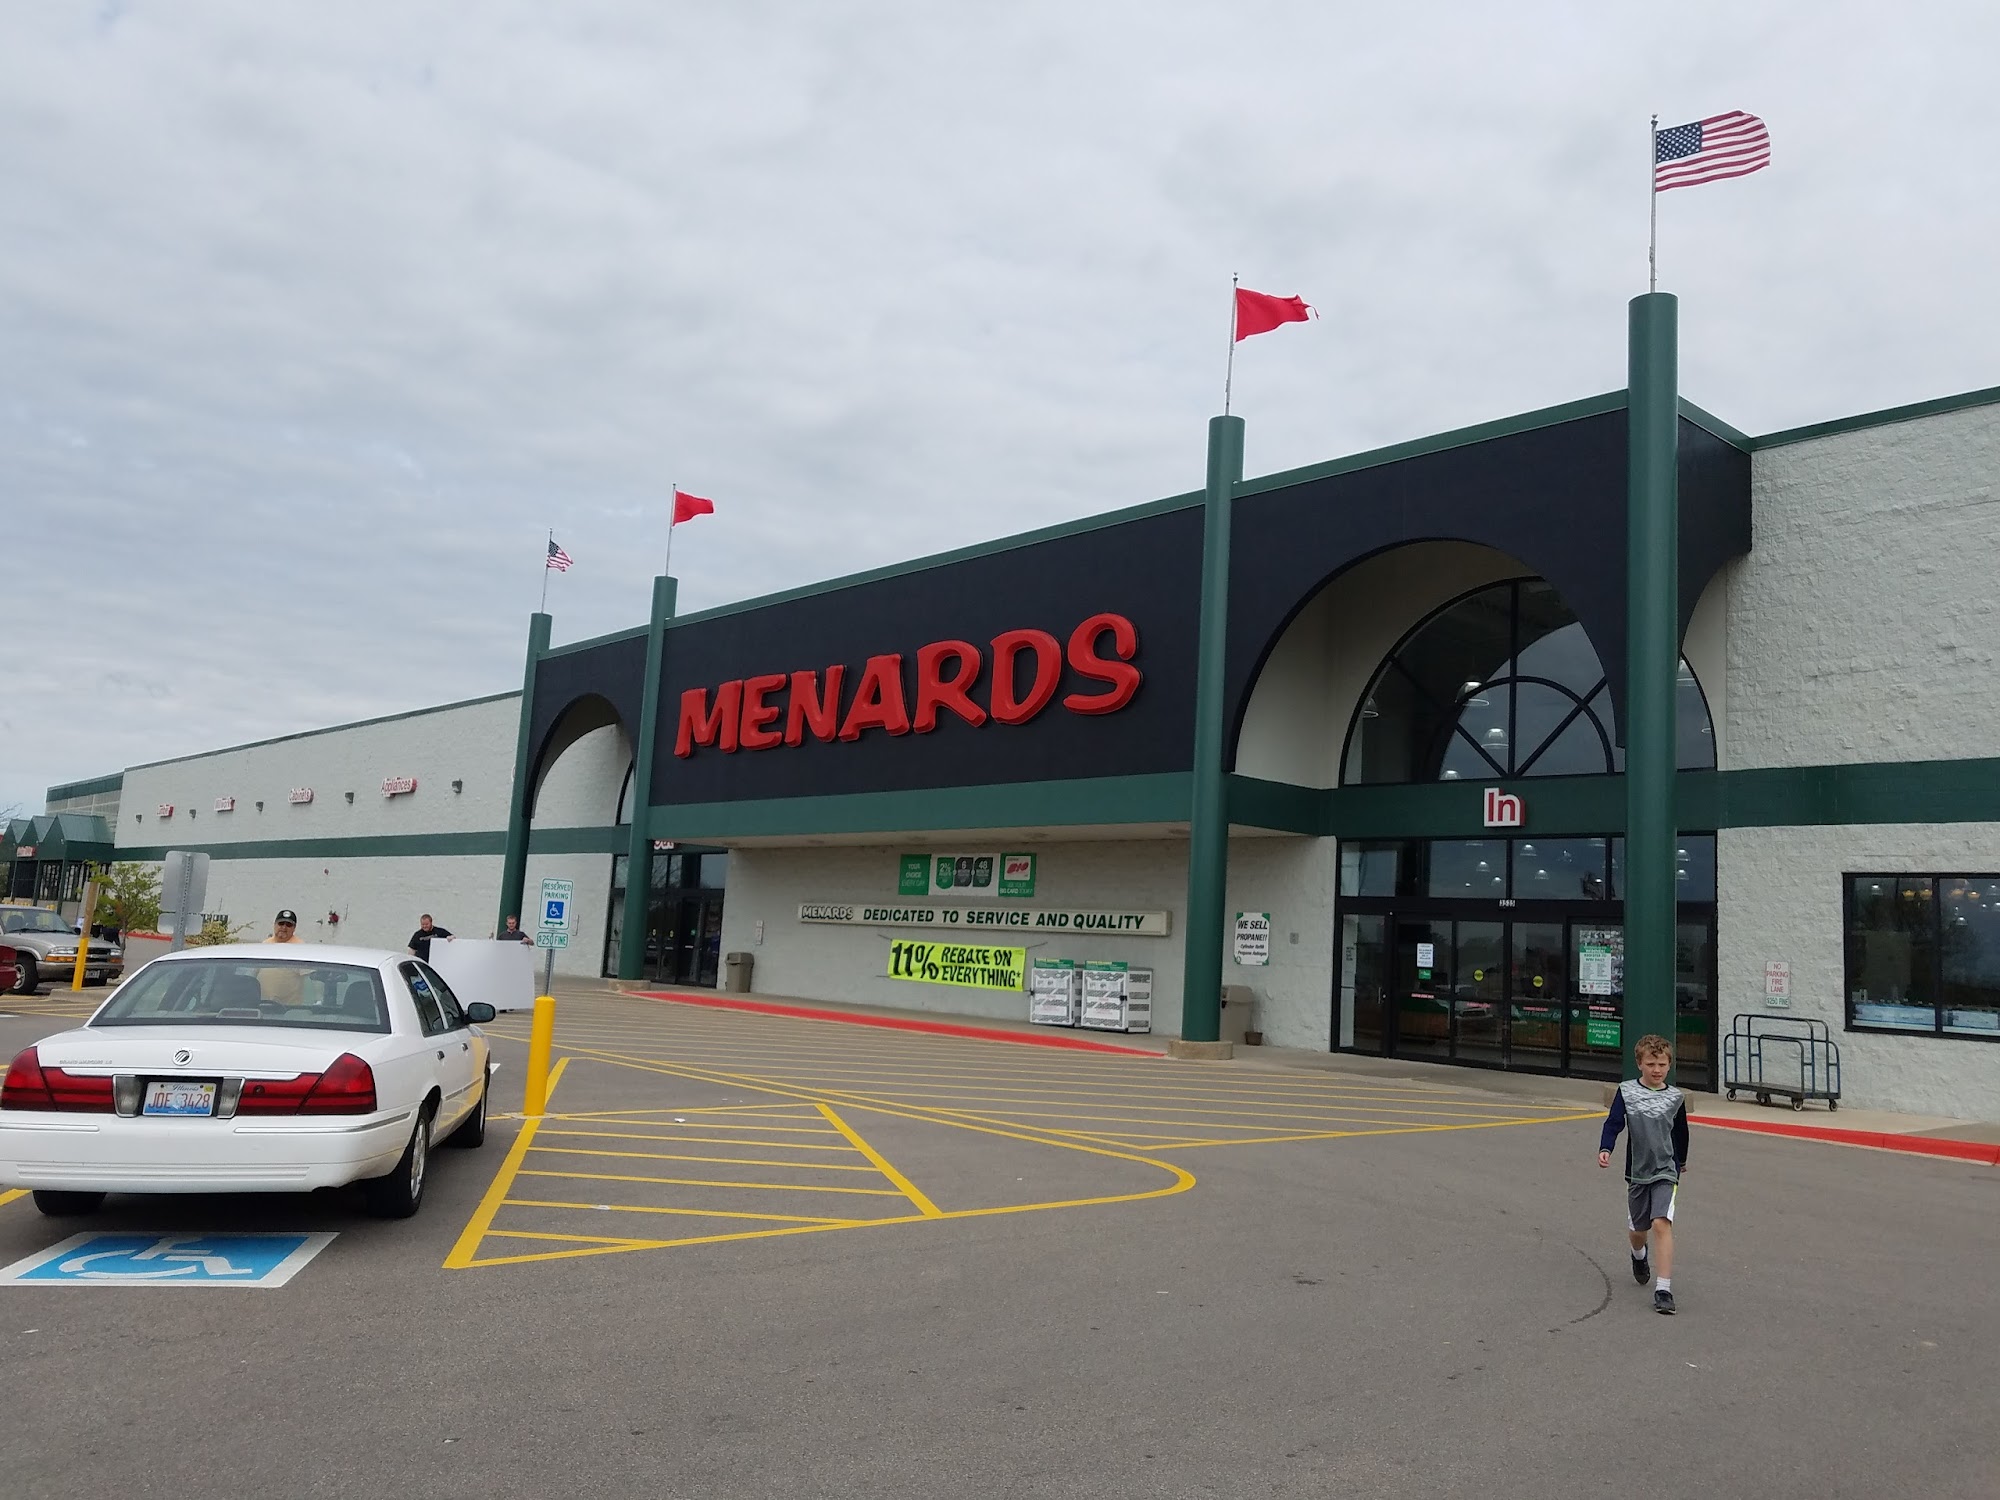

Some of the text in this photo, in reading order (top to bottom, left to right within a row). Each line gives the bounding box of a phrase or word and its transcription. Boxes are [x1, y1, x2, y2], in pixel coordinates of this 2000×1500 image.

[674, 612, 1142, 759] MENARDS
[381, 777, 413, 796] Appliances
[1486, 790, 1518, 825] In
[940, 862, 952, 872] 2%
[961, 860, 967, 869] 6
[978, 860, 988, 869] 48
[544, 883, 571, 891] RESERVED
[544, 891, 569, 900] PARKING
[802, 905, 1145, 930] MENARDS DEDICATED TO SERVICE AND QUALITY
[1238, 920, 1268, 930] WE SELL
[538, 934, 567, 946] $250 FINE
[1236, 933, 1268, 942] PROPANE!!
[892, 943, 1012, 980] 11% REBATE ON
[1766, 970, 1788, 978] PARKING
[172, 1084, 199, 1092] Illinois
[181, 1092, 211, 1109] 3428
